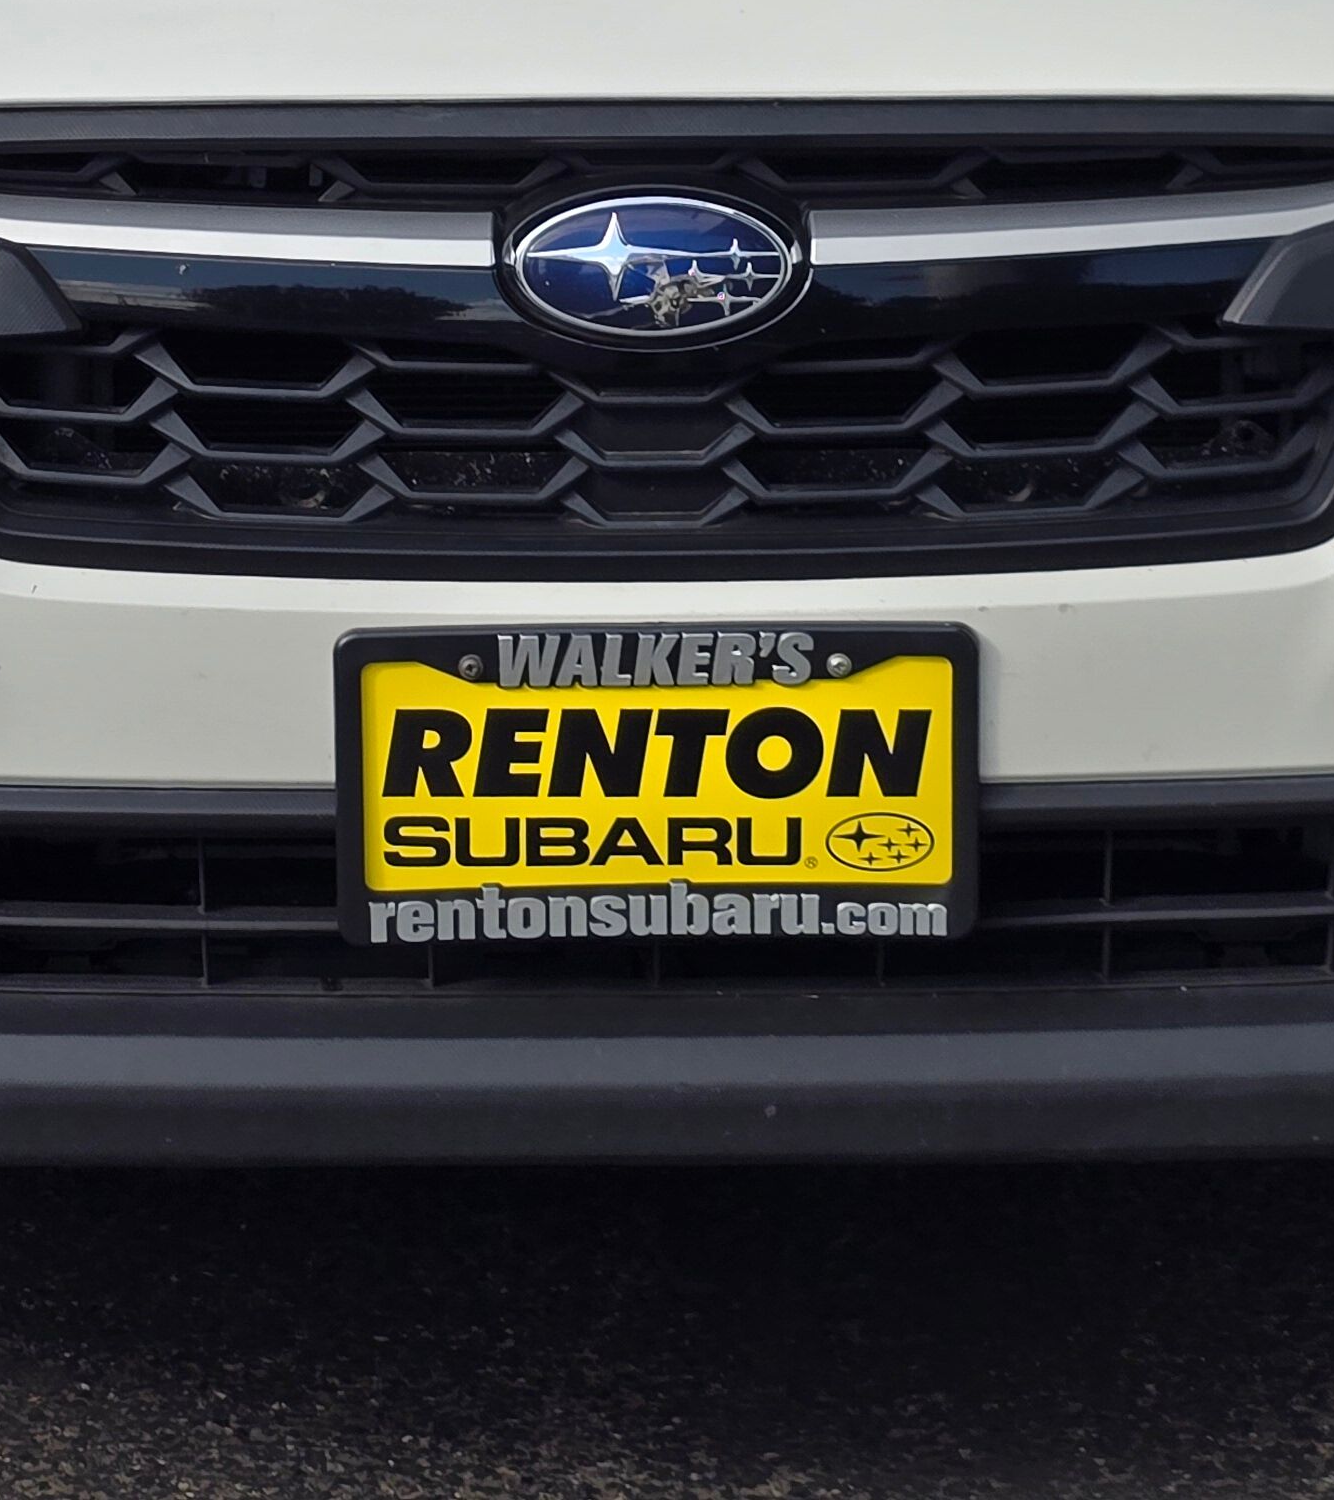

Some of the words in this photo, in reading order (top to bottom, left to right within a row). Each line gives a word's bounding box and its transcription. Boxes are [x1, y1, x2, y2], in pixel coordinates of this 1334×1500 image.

[497, 632, 814, 689] WALKER'S
[381, 706, 933, 799] RENTON
[383, 816, 803, 867] SUBARU
[368, 880, 948, 943] rentonsubaru.com
